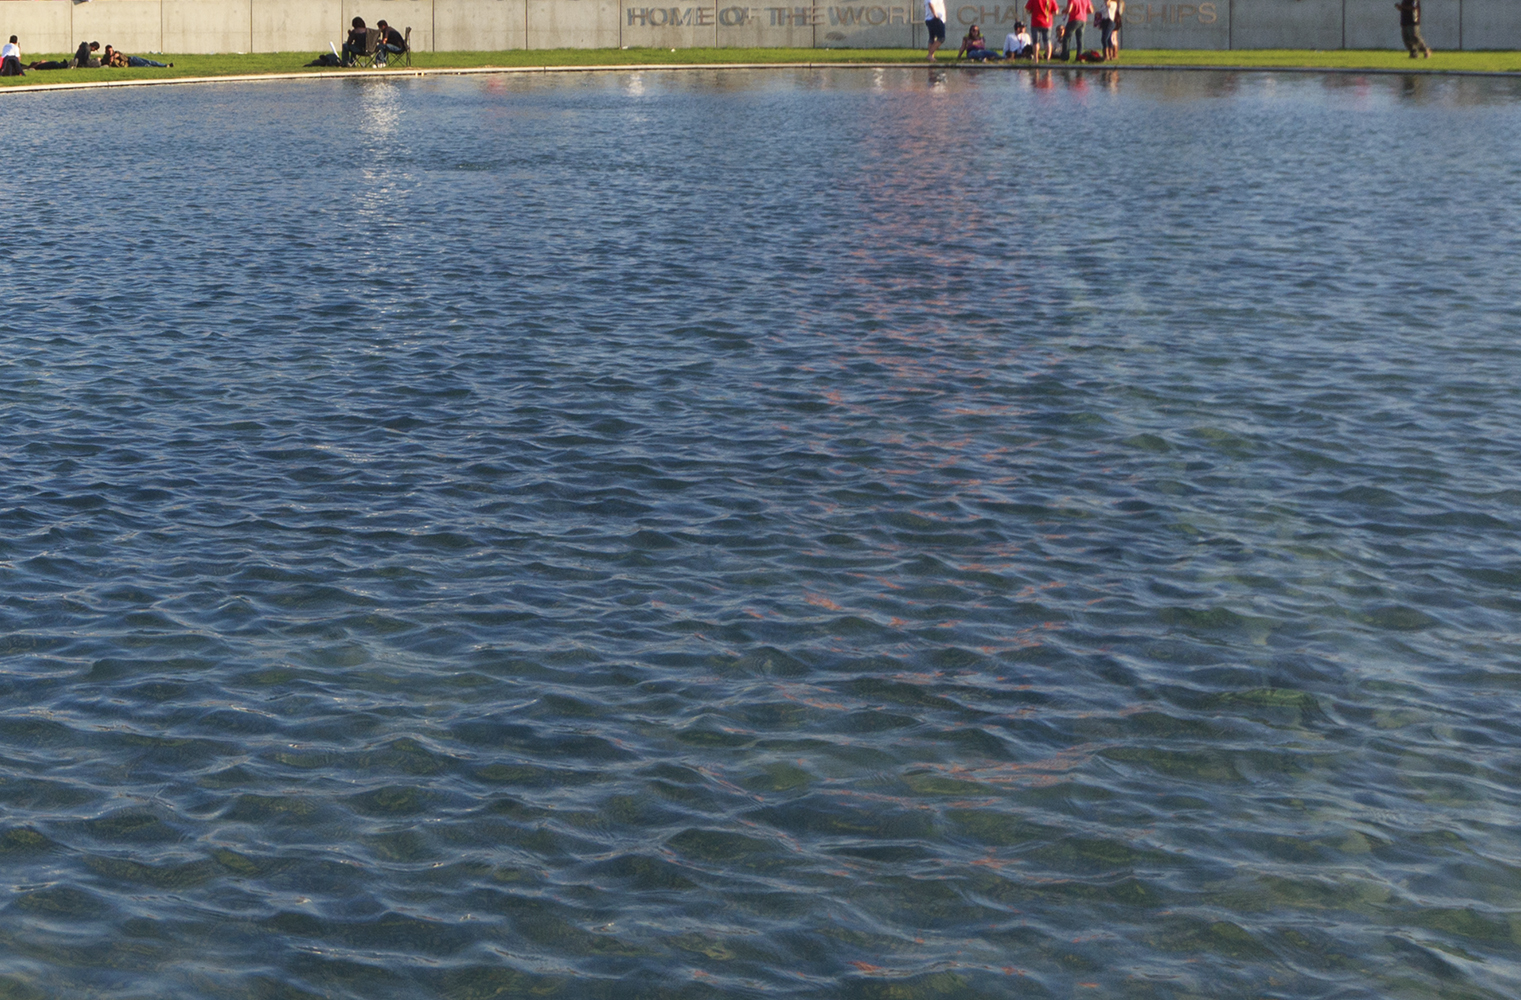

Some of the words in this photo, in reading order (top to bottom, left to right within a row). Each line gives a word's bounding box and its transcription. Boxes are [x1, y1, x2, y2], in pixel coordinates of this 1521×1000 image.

[627, 7, 715, 26] HOME
[763, 6, 825, 26] THE
[828, 5, 925, 25] WORL
[957, 2, 1217, 25] CHASHIPS
